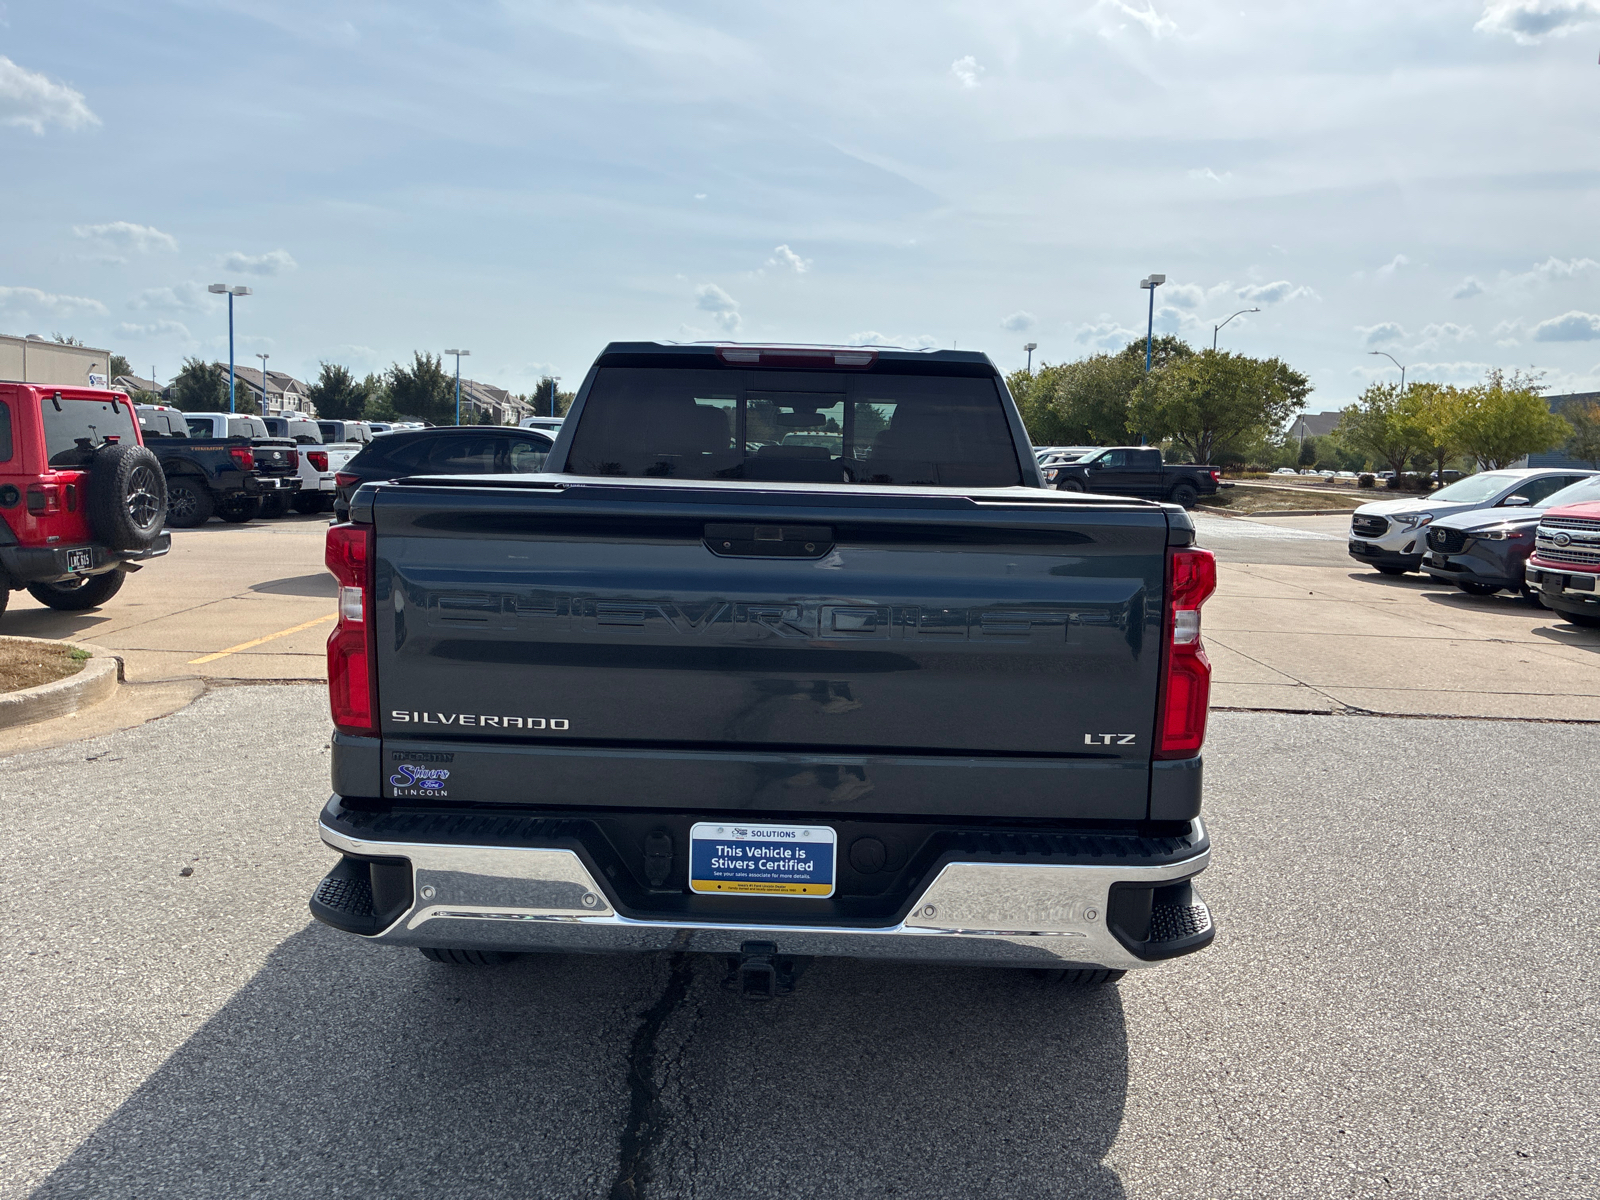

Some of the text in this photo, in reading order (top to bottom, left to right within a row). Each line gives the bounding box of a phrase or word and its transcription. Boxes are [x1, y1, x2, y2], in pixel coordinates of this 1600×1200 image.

[427, 593, 1110, 643] CHEVROLET
[391, 710, 570, 730] SILVERADO
[1084, 733, 1136, 745] LTZ
[390, 764, 450, 788] Stivers
[751, 830, 796, 839] SOLUTIONS
[716, 845, 806, 858] This Vehicle is
[711, 857, 813, 871] Stivers Certified
